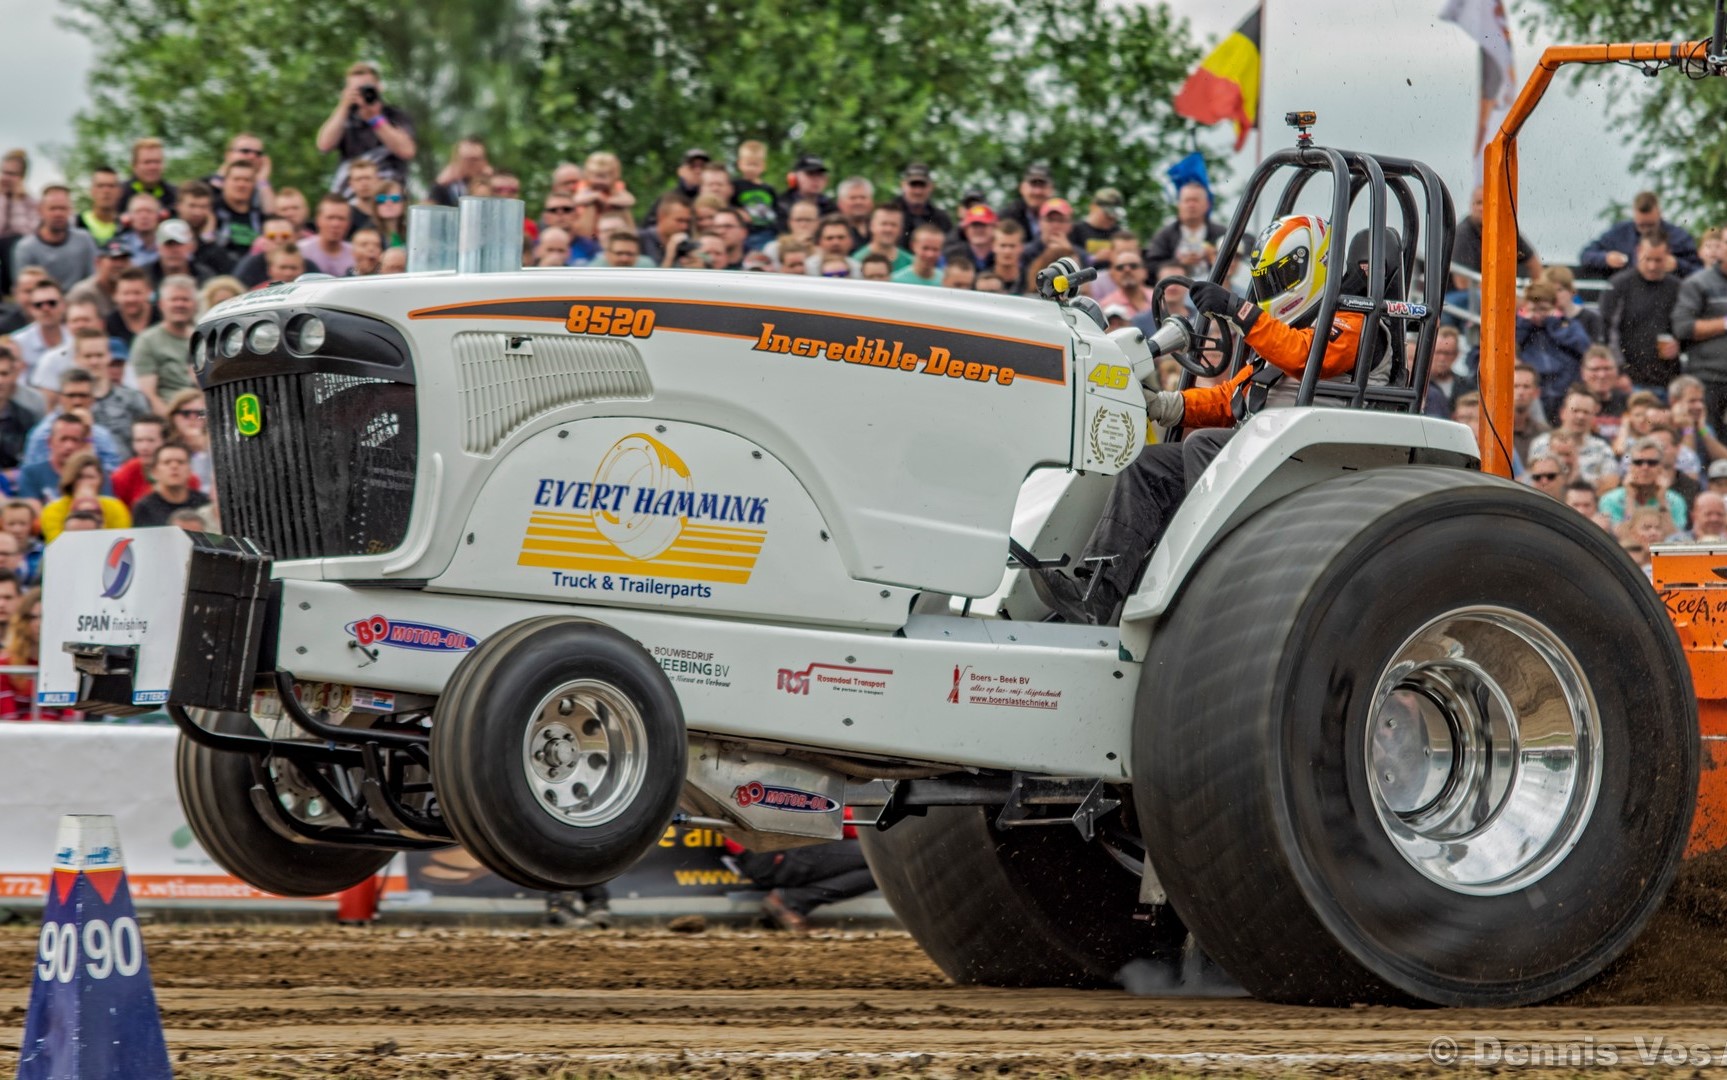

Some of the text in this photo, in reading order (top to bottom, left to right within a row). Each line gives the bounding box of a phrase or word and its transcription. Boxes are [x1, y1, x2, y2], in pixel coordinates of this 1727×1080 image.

[565, 304, 656, 339] 8520
[751, 322, 1016, 386] Incredible Deere
[1088, 363, 1131, 390] 46
[533, 478, 769, 524] EVERT HAMMINK
[552, 571, 712, 598] Truck & Trailerparts
[1660, 590, 1709, 623] Keep
[77, 615, 148, 633] SPAN finishing
[354, 614, 469, 649] BO MOTOR-OIL
[654, 646, 714, 661] BOUWBEDRIJF
[714, 664, 730, 677] BV
[853, 678, 886, 688] Transport
[970, 673, 992, 682] Boers
[999, 675, 1018, 684] Beek
[1019, 676, 1030, 685] BV
[135, 690, 168, 701] LETTERS
[970, 695, 1057, 708] www.boerslastechniek.nl
[736, 781, 829, 810] BO MOTOR-OIL
[37, 921, 79, 984] 90
[82, 916, 142, 980] 90
